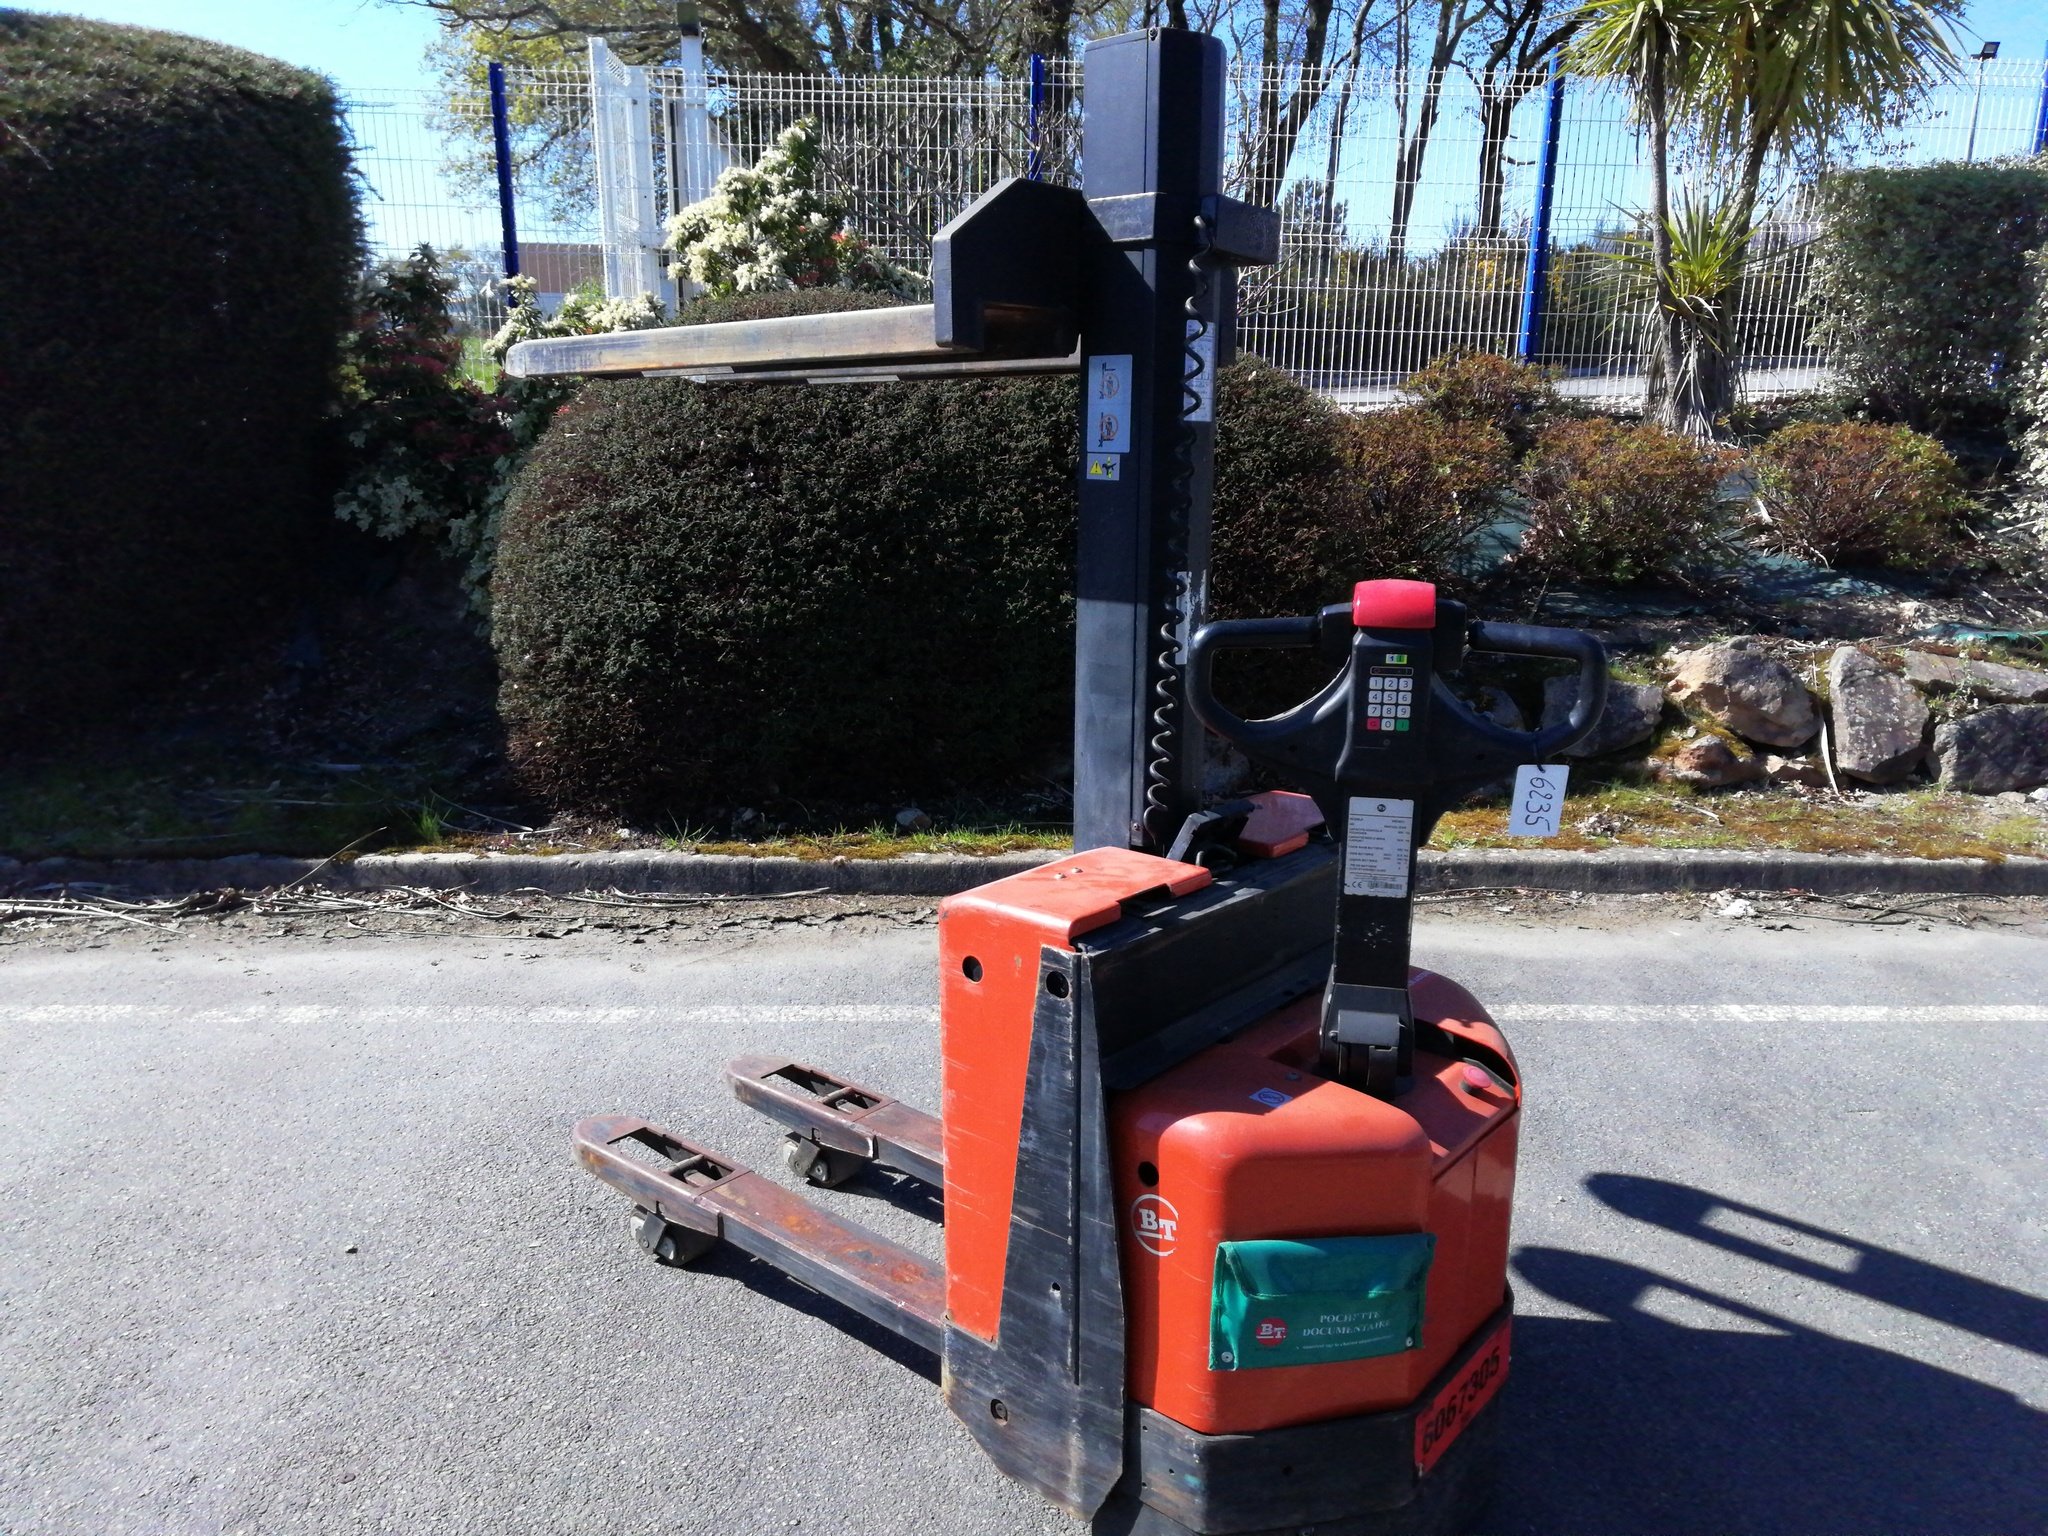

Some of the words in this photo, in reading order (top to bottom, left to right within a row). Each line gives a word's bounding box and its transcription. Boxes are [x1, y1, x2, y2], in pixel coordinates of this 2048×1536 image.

[1388, 680, 1394, 688] 2
[1372, 693, 1378, 701] 4
[1402, 694, 1408, 702] 6
[1386, 707, 1392, 715] 8
[1401, 708, 1407, 716] 9
[1525, 776, 1556, 832] 6235
[1138, 1207, 1177, 1242] BT
[1319, 1311, 1382, 1324] POCHETTE
[1302, 1319, 1392, 1337] DOCUMENTAIRE
[1422, 1347, 1500, 1455] 6067305
